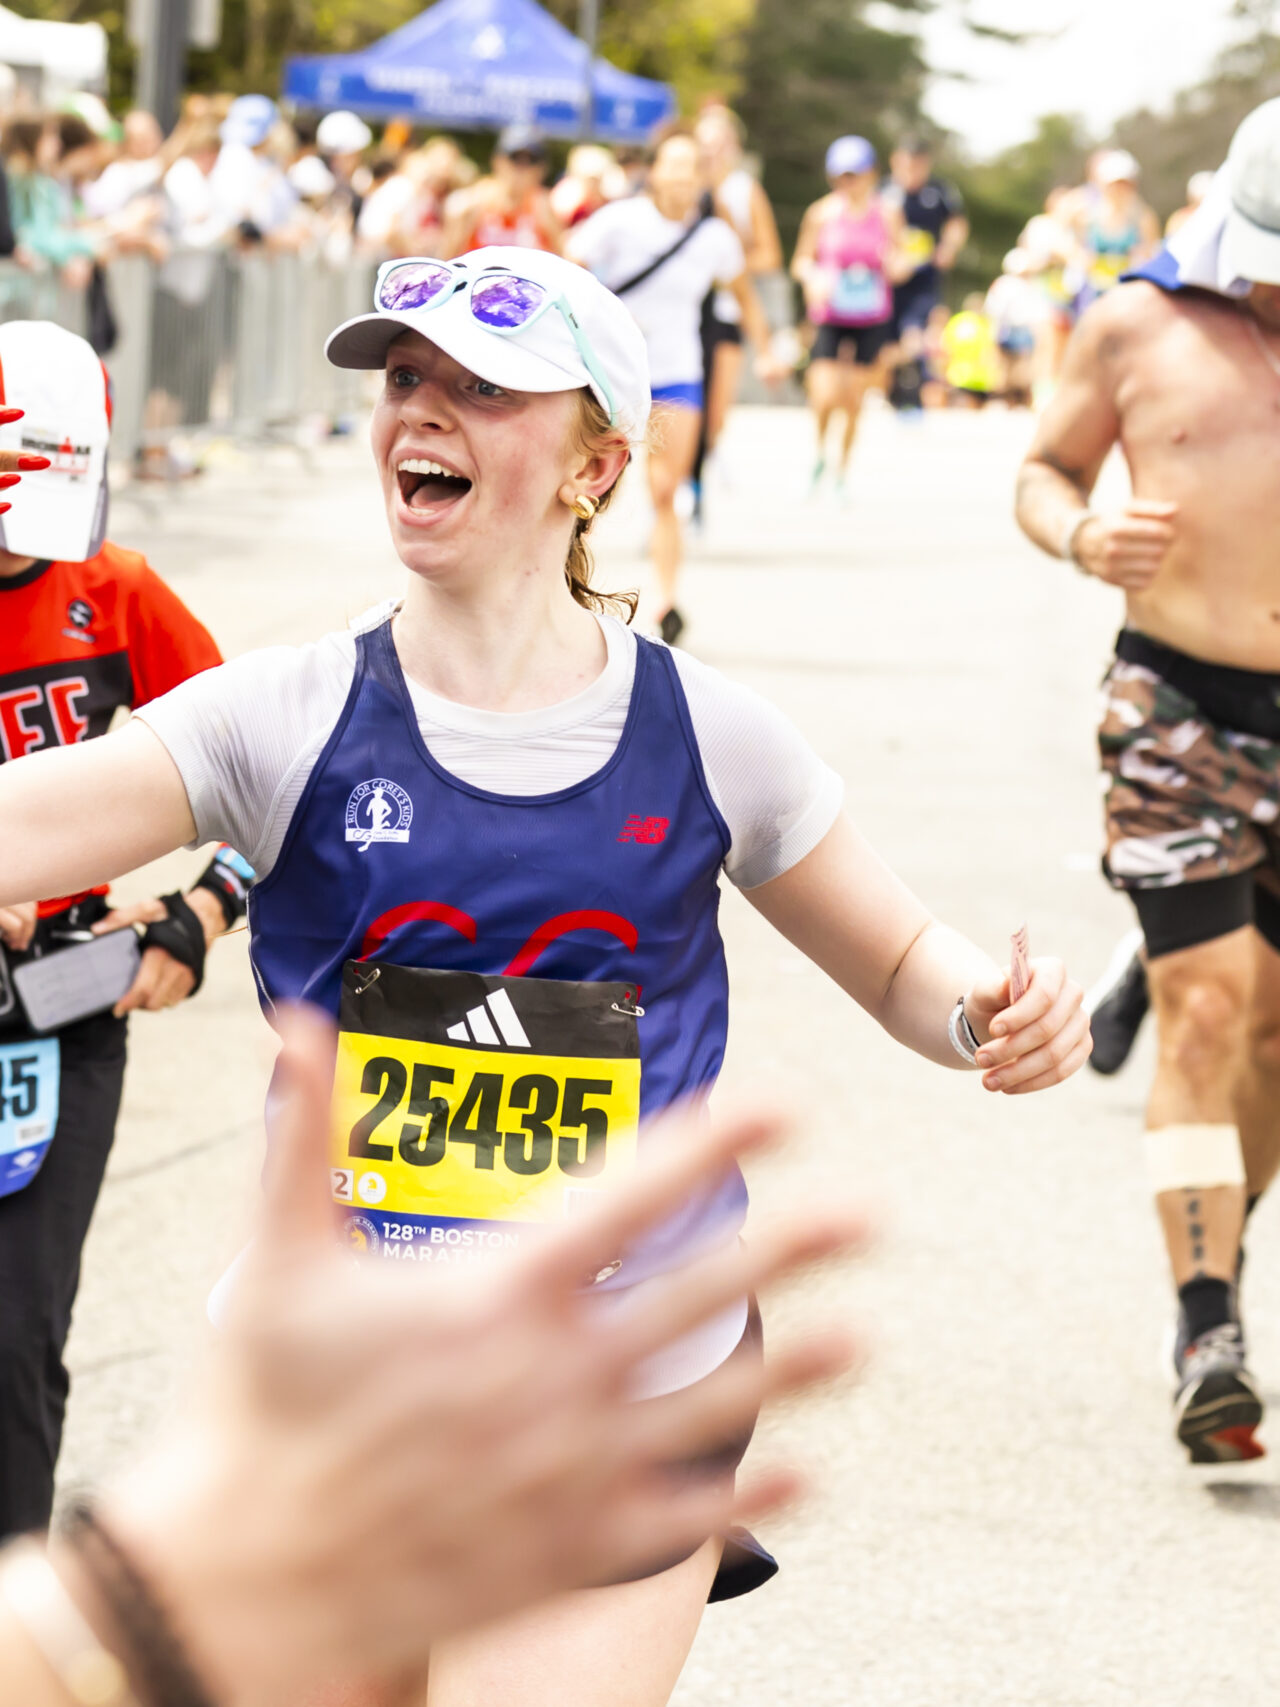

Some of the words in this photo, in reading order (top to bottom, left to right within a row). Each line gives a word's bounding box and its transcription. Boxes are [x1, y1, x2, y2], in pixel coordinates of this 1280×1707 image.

[353, 784, 371, 800] FOR
[372, 781, 409, 805] COREY'S
[400, 805, 410, 827] KIDS
[348, 1056, 613, 1178] 25435
[333, 1172, 349, 1196] 2
[430, 1227, 520, 1249] BOSTON
